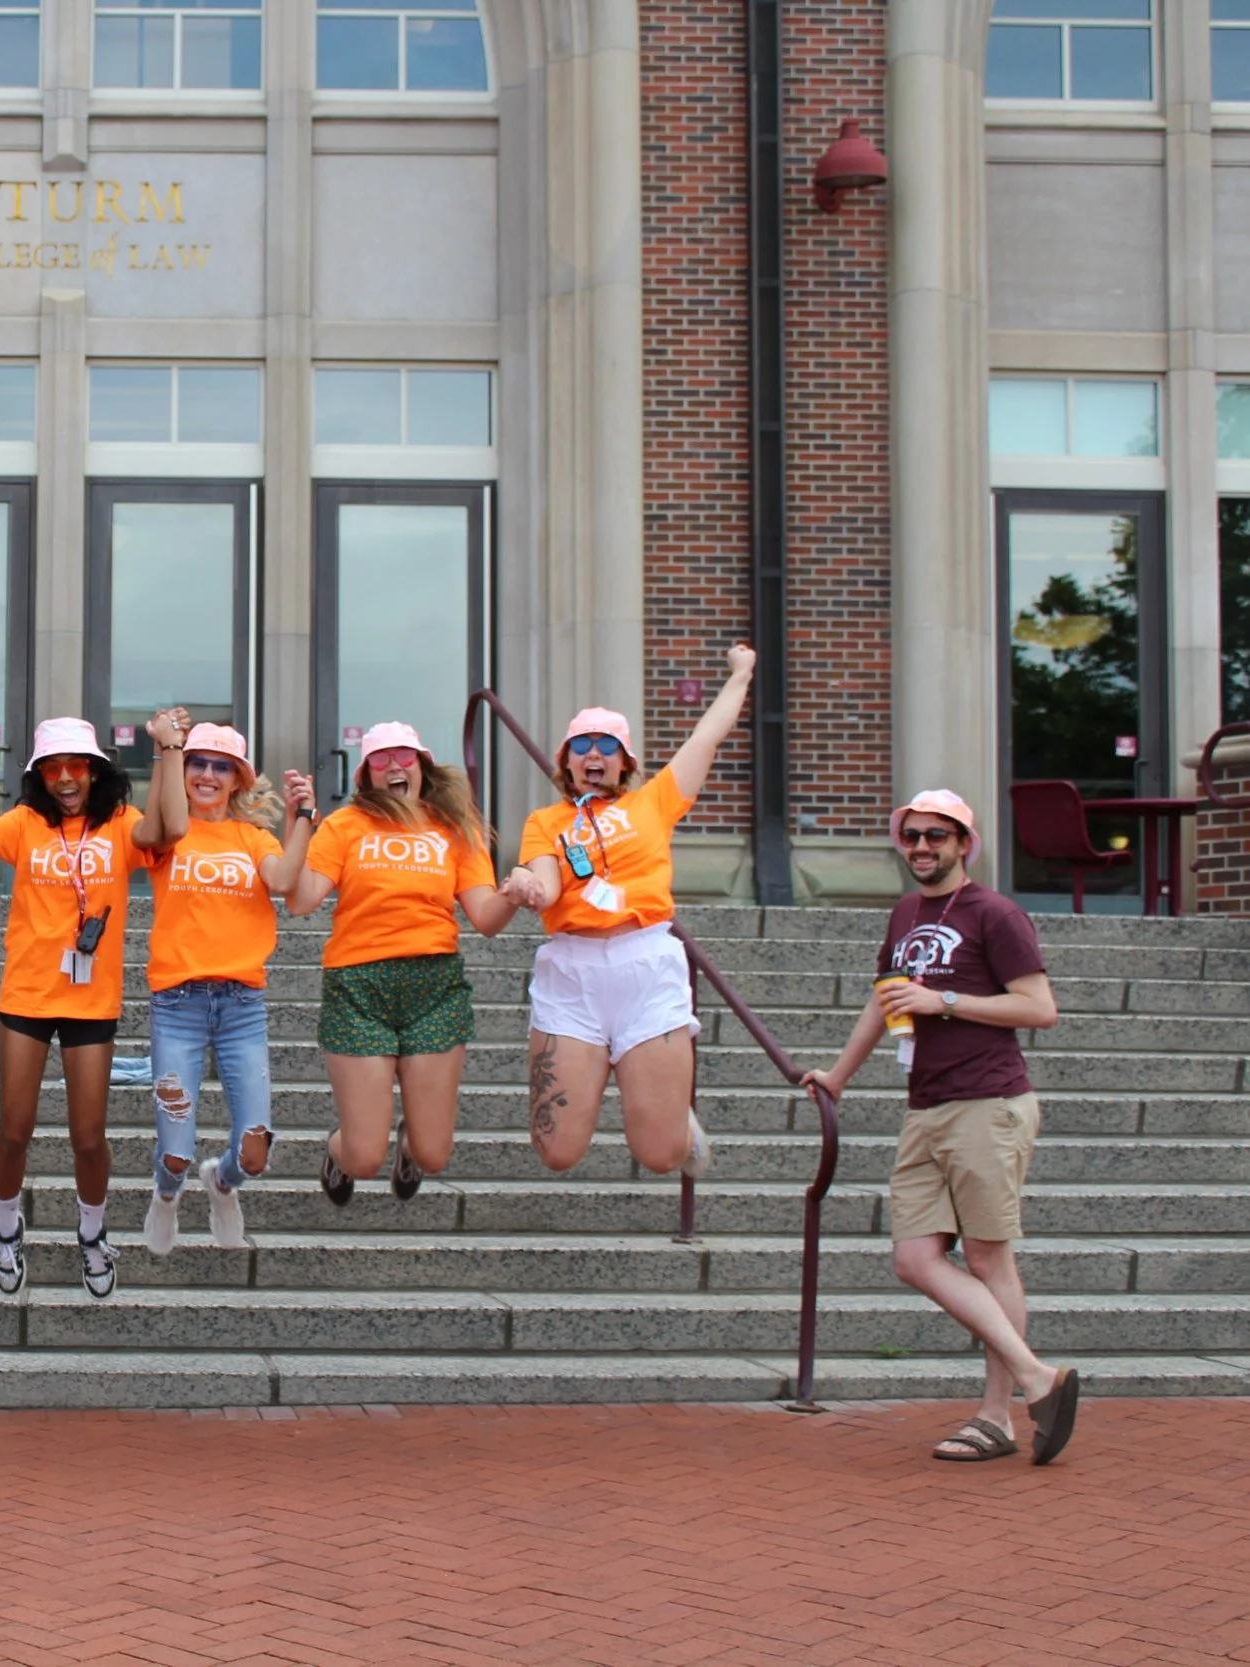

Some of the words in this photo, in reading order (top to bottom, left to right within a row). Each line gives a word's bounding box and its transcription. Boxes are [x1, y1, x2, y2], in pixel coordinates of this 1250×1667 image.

[90, 229, 121, 279] of
[128, 244, 211, 270] LAW
[31, 836, 113, 877] HOBY
[358, 862, 388, 870] YOUTH
[359, 831, 449, 866] HOBY
[170, 851, 256, 889] HOBY
